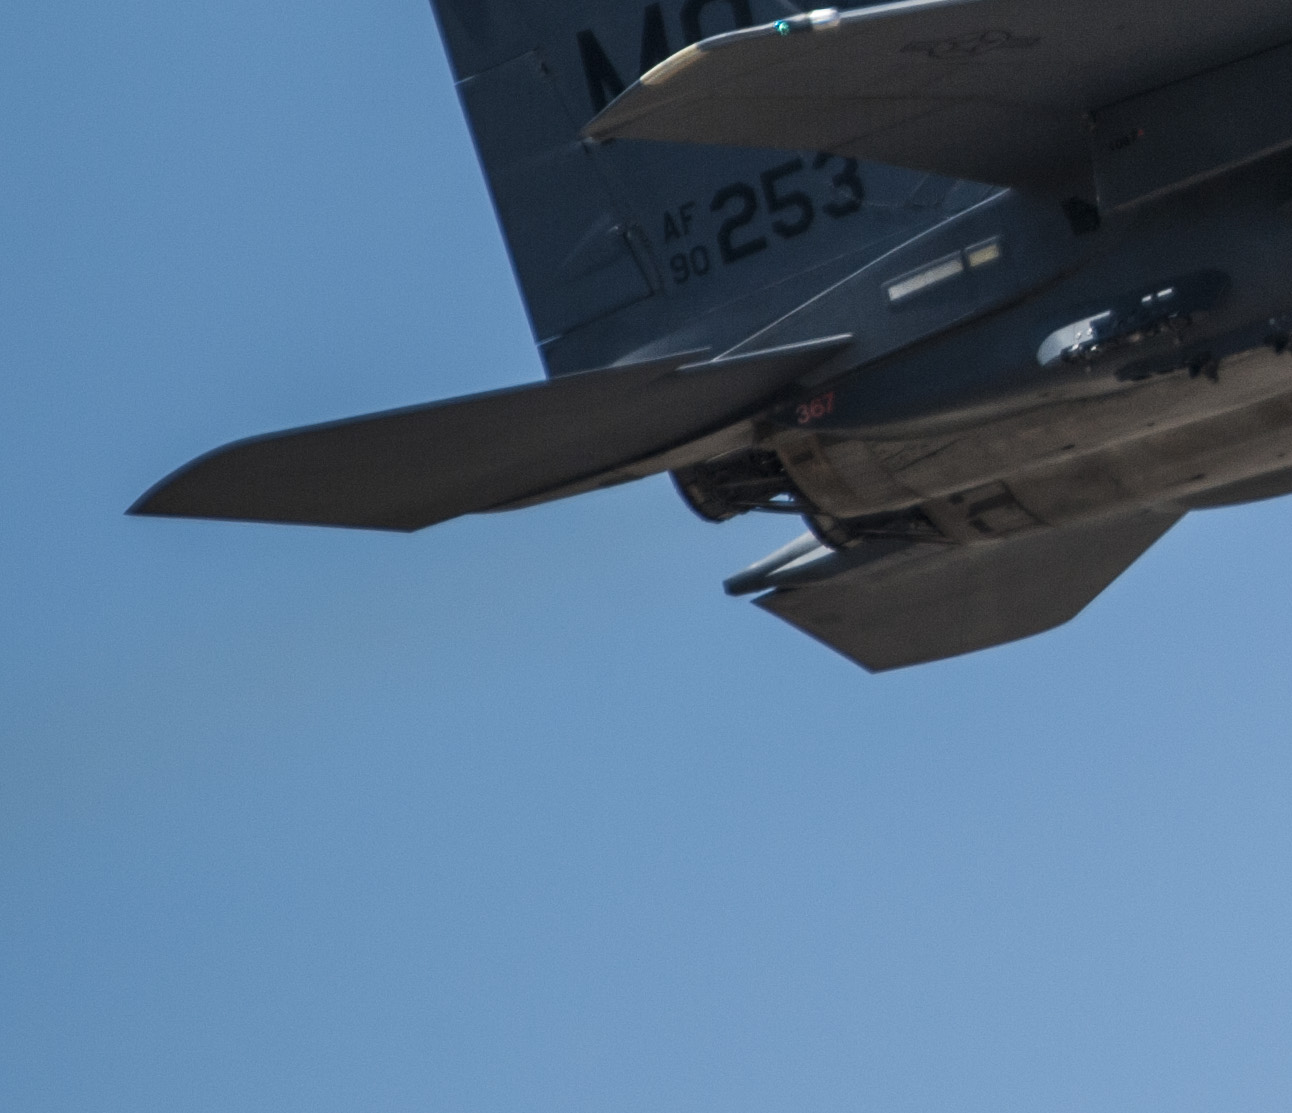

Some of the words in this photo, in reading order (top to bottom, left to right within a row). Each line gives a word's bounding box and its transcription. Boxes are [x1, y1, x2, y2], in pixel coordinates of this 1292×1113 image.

[663, 201, 697, 243] AF
[709, 152, 865, 265] 253
[670, 246, 709, 284] 90
[795, 391, 835, 424] 367
